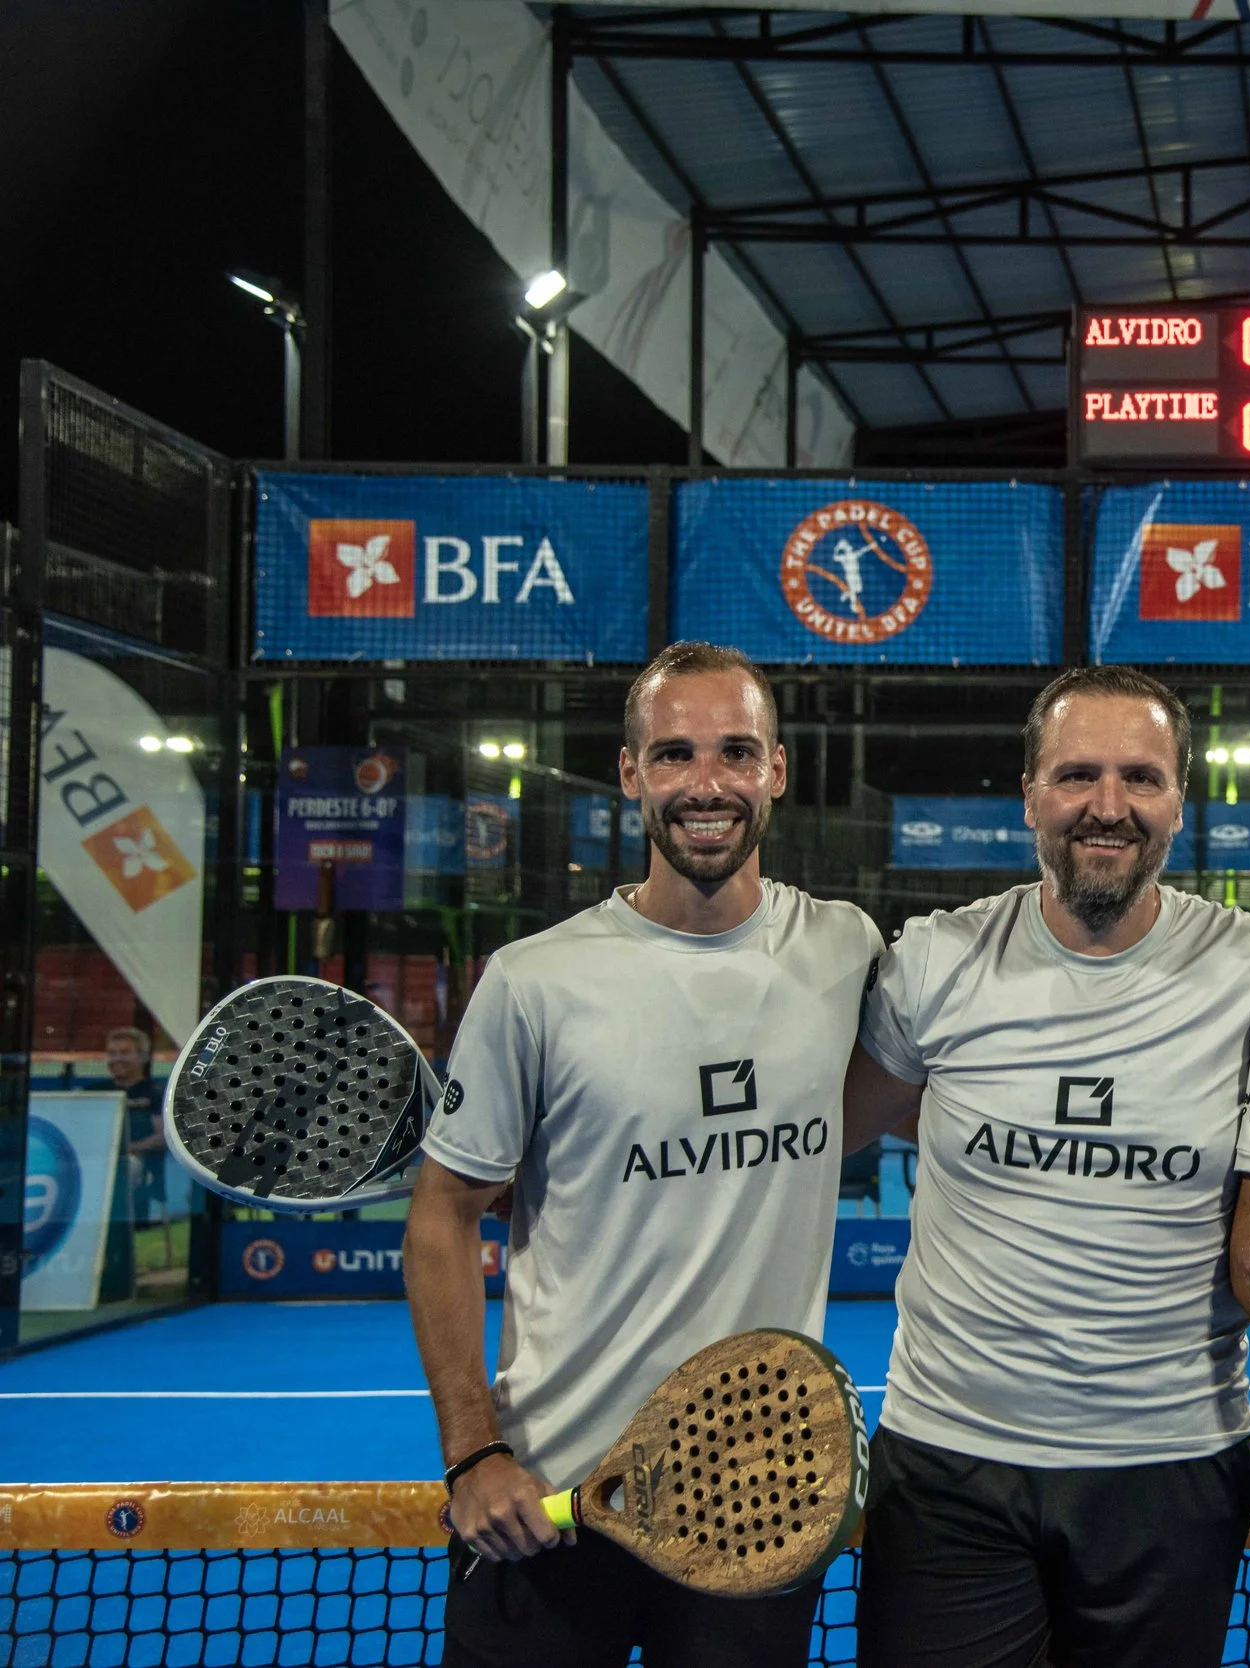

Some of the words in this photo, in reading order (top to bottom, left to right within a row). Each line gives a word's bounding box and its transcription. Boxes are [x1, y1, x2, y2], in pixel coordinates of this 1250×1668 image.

[1086, 318, 1202, 345] ALVIDRO
[1086, 393, 1218, 420] PLAYTIME
[786, 528, 817, 569] THE
[816, 505, 891, 529] PADEL
[896, 528, 927, 570] CUP
[423, 536, 575, 604] BFA
[796, 597, 875, 640] UNITEL
[880, 597, 919, 632] BFA
[288, 798, 358, 818] PERDESTE
[623, 1117, 827, 1182] ALVIDRO
[965, 1122, 1200, 1181] ALVIDRO
[339, 1249, 404, 1271] UNIT
[274, 1508, 350, 1524] ALCAAL
